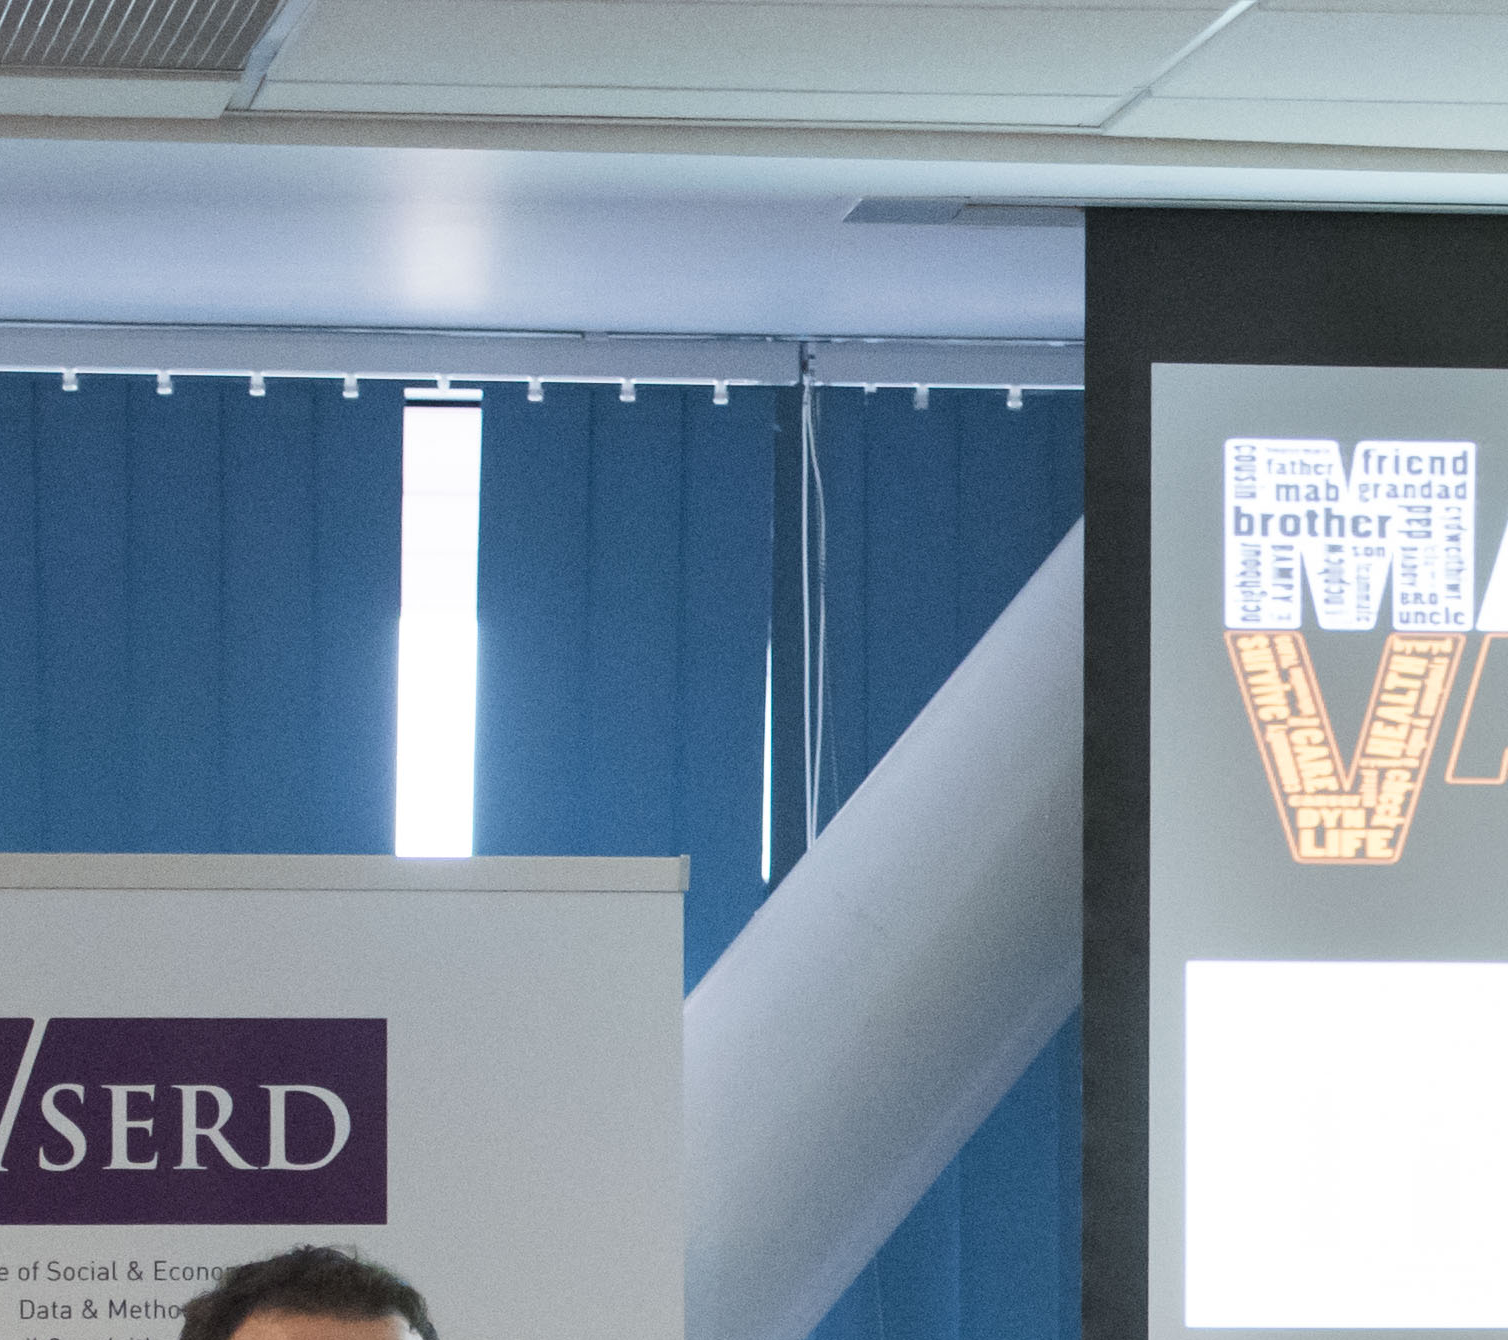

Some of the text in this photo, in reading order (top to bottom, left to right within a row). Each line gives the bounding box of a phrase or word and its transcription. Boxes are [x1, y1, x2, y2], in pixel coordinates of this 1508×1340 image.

[1266, 458, 1334, 476] father
[1362, 447, 1470, 477] friend
[1275, 478, 1341, 503] mab
[1358, 479, 1469, 503] grandad
[1233, 504, 1393, 539] brother
[1398, 606, 1466, 626] uncle
[1365, 655, 1429, 758] HEALTH
[1298, 829, 1395, 858] LIFE
[17, 1260, 41, 1282] of
[47, 1260, 118, 1282] Social
[127, 1260, 144, 1282] &
[154, 1260, 234, 1282] Econo
[19, 1298, 185, 1320] Data & Metho
